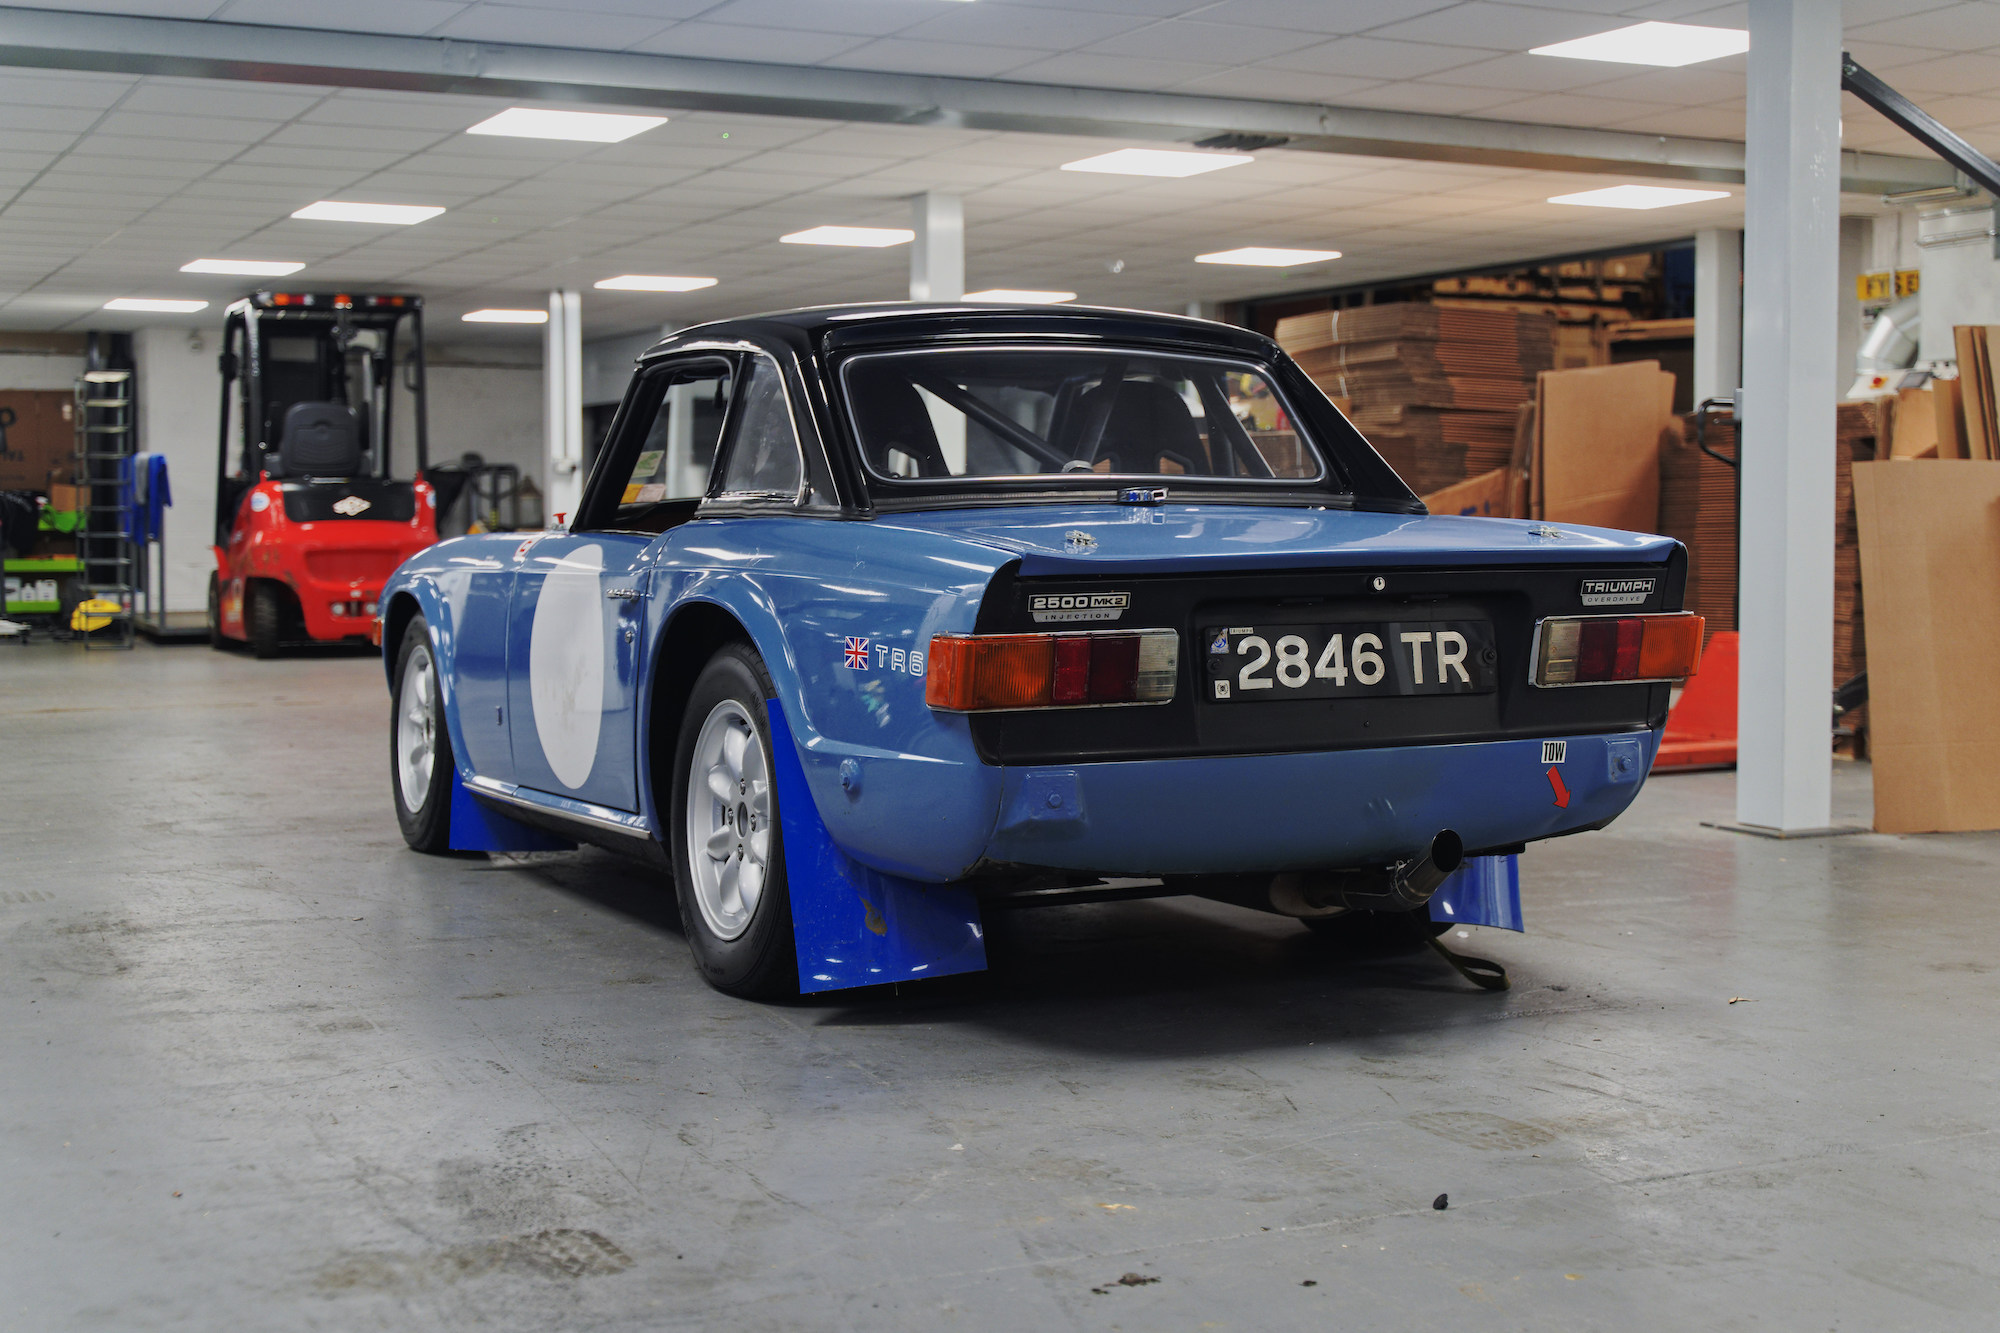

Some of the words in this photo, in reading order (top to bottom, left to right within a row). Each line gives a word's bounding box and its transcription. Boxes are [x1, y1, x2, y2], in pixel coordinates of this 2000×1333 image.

[1586, 581, 1652, 593] TRIUMPH
[1033, 596, 1088, 609] 2500
[1093, 597, 1123, 606] MK2
[1587, 595, 1641, 603] OVERDRIVE
[875, 644, 924, 677] TR6
[1237, 632, 1385, 690] 2846
[1400, 631, 1470, 685] TR
[1544, 742, 1565, 761] TOW
